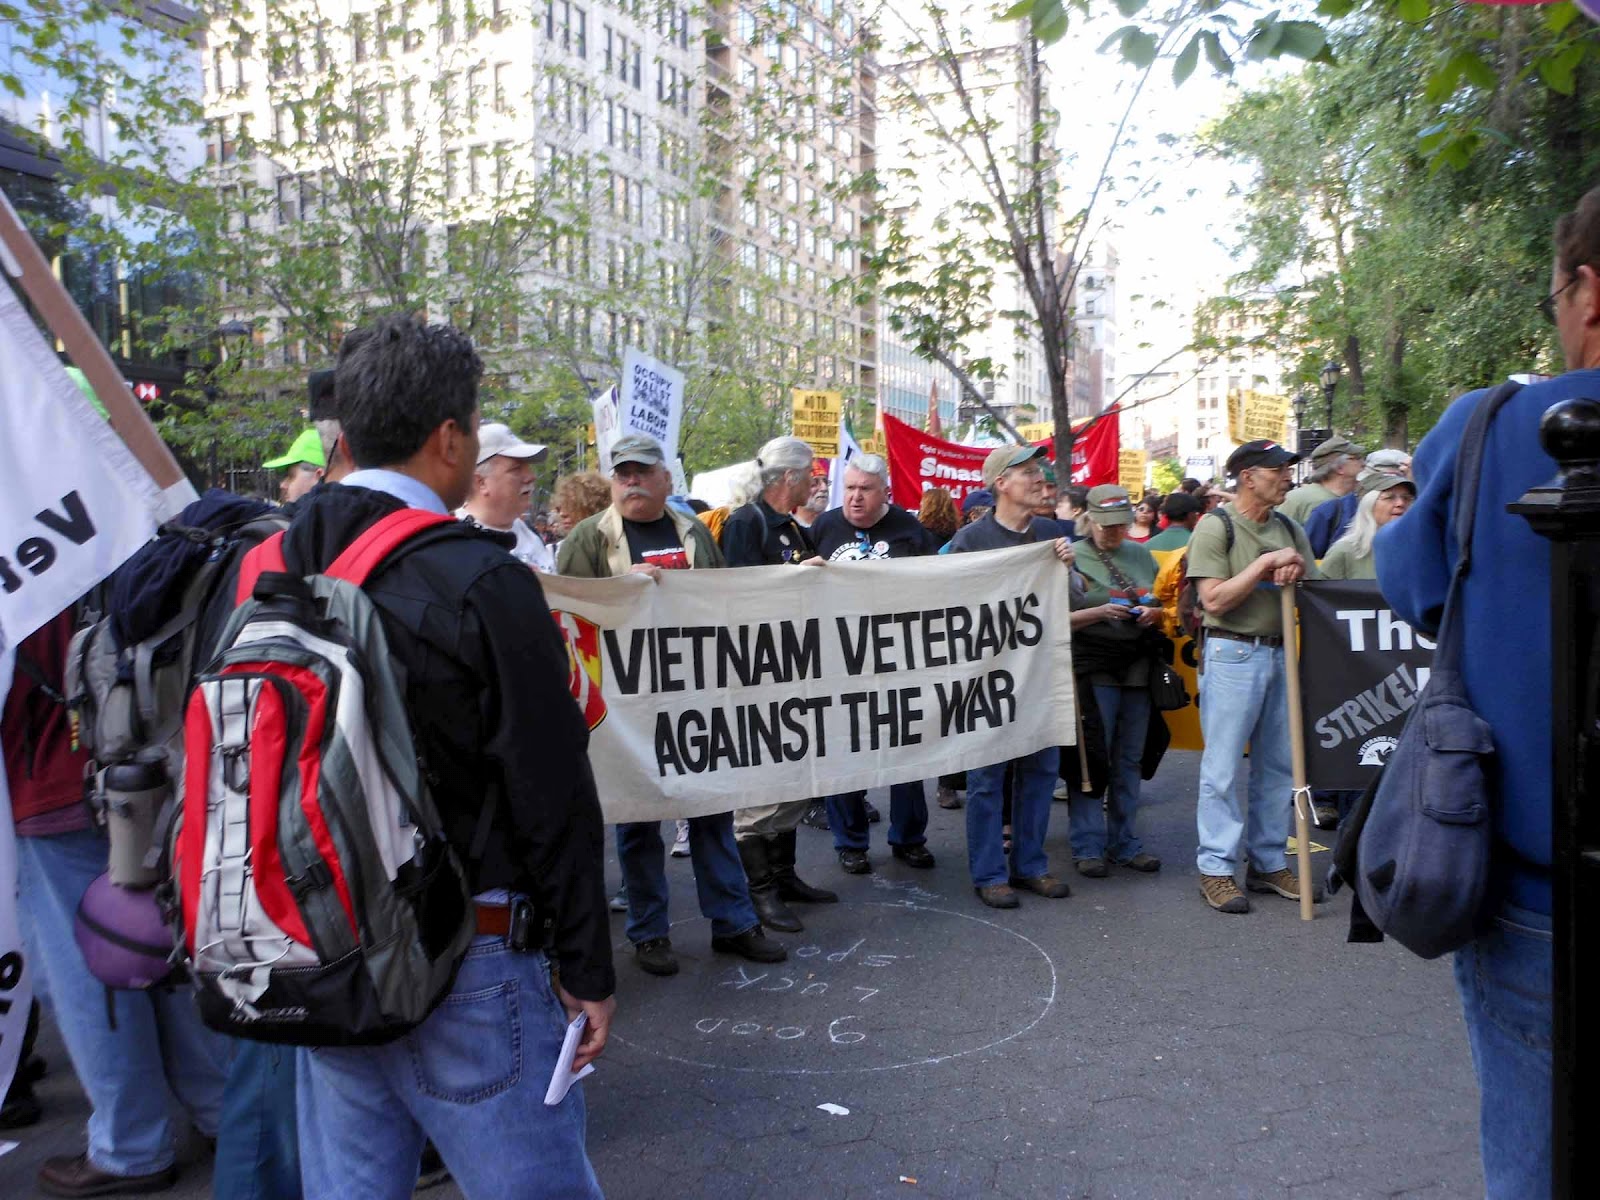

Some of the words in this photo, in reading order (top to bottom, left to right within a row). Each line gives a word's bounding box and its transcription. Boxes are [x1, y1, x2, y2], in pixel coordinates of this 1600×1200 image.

[634, 364, 672, 390] OCCUPY
[631, 405, 667, 430] LABOR
[630, 419, 667, 442] ALLIANCE
[919, 457, 983, 482] Smas
[603, 618, 822, 695] VIETNAM
[836, 592, 1043, 676] VETERANS
[654, 696, 832, 777] AGAINST
[841, 686, 924, 753] THE
[934, 669, 1016, 739] WAR
[1358, 735, 1387, 755] VETERANS
